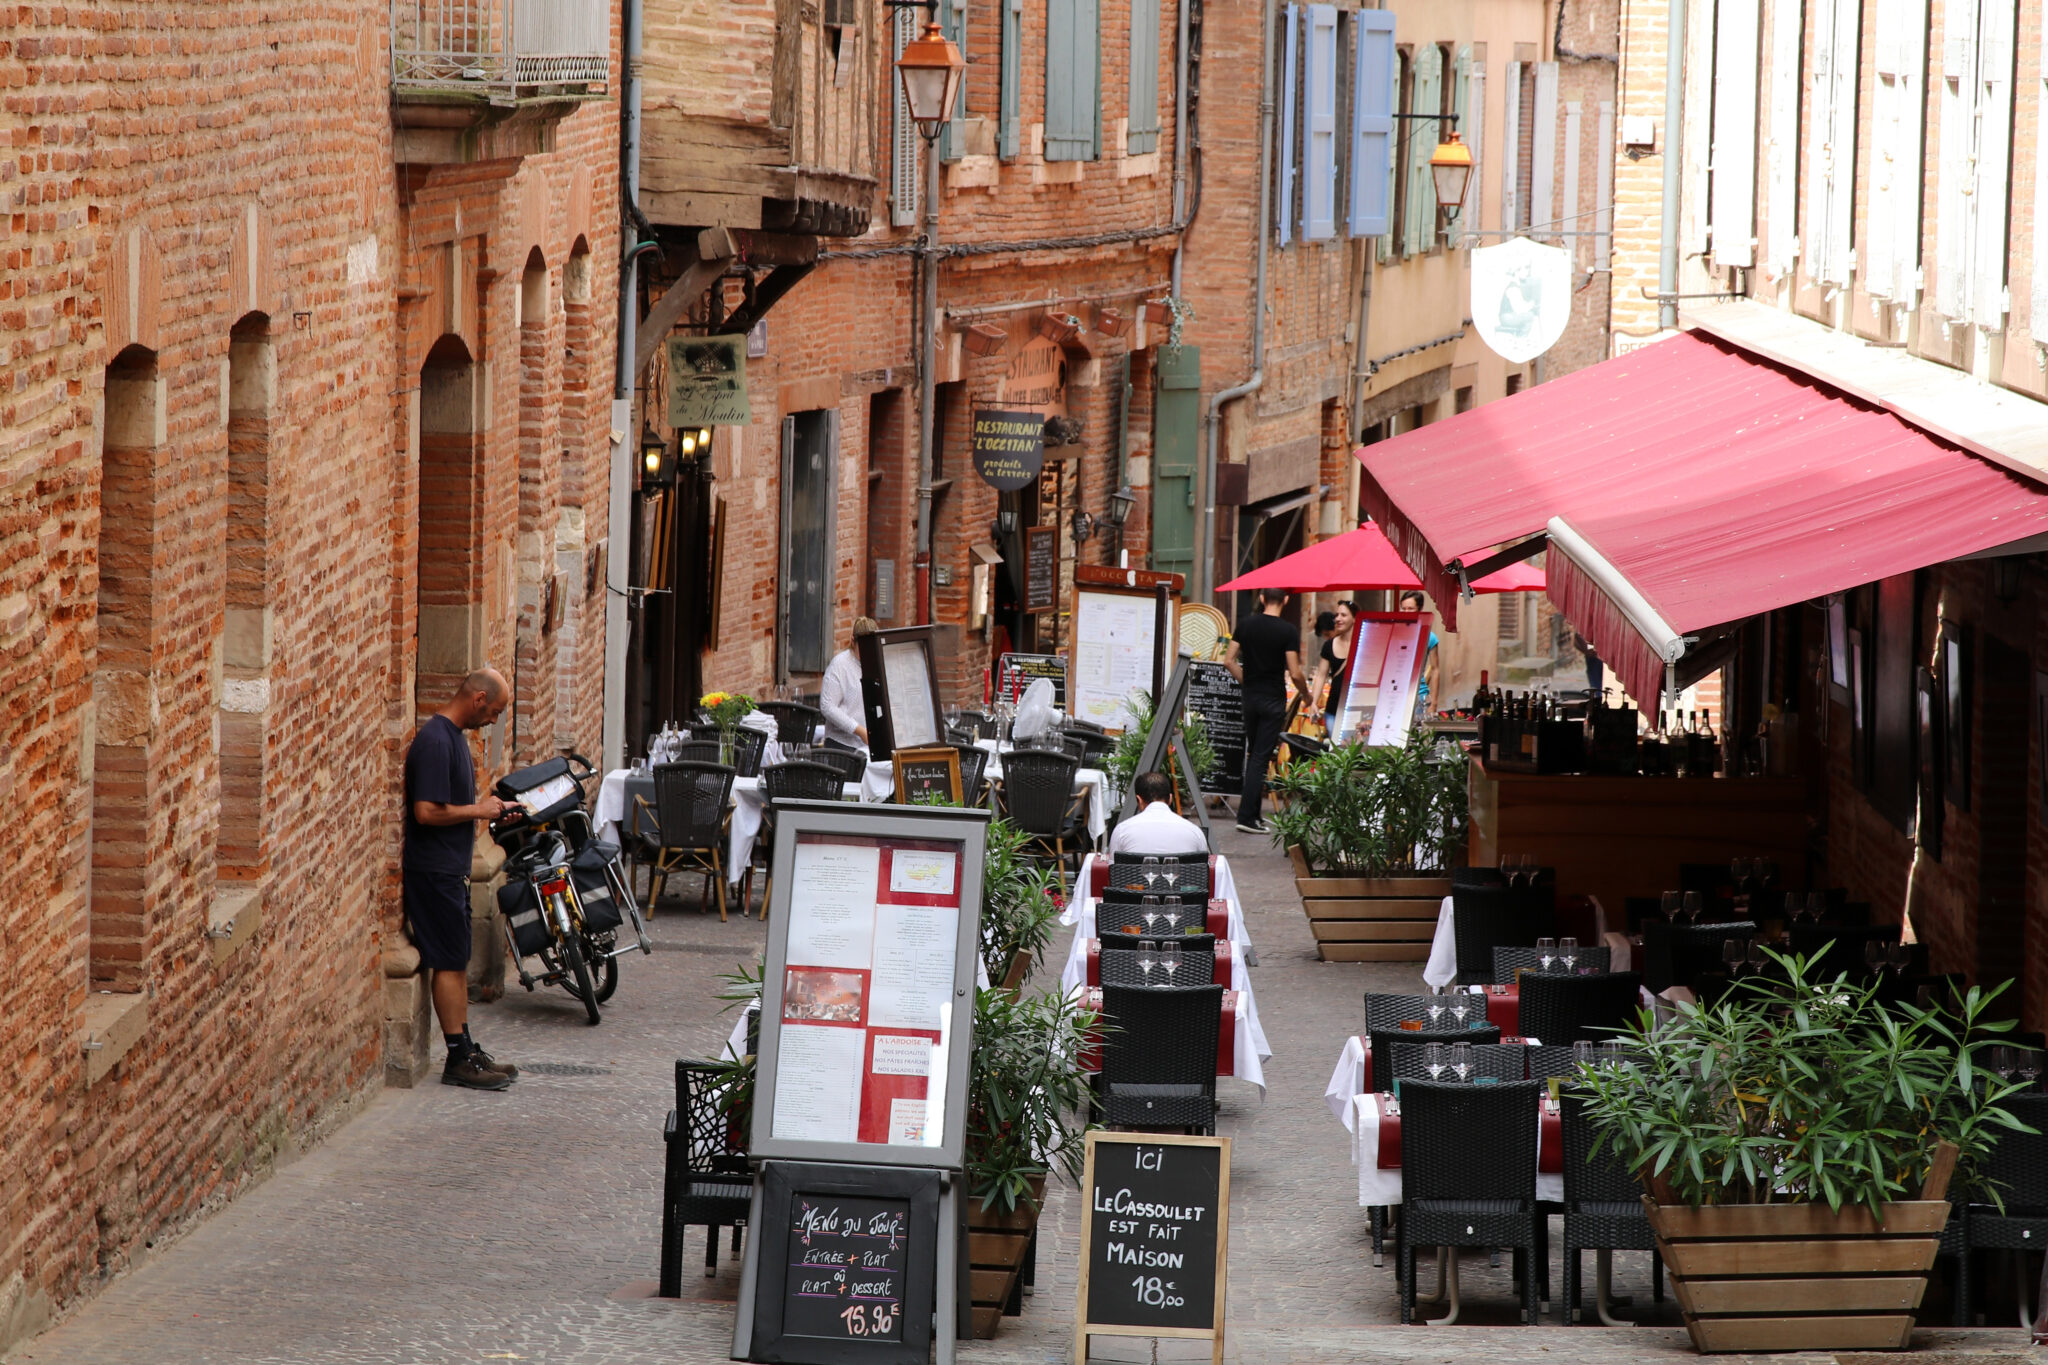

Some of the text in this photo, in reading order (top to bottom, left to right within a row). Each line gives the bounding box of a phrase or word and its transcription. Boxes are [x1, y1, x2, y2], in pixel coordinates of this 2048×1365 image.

[676, 403, 744, 420] du Moulin
[976, 421, 1044, 436] RESTAURANT
[983, 458, 1022, 469] produits
[1090, 568, 1161, 583] L'OCCTA
[1108, 1220, 1139, 1235] EST
[863, 1250, 890, 1267] PLAT
[801, 1279, 831, 1293] PLAT
